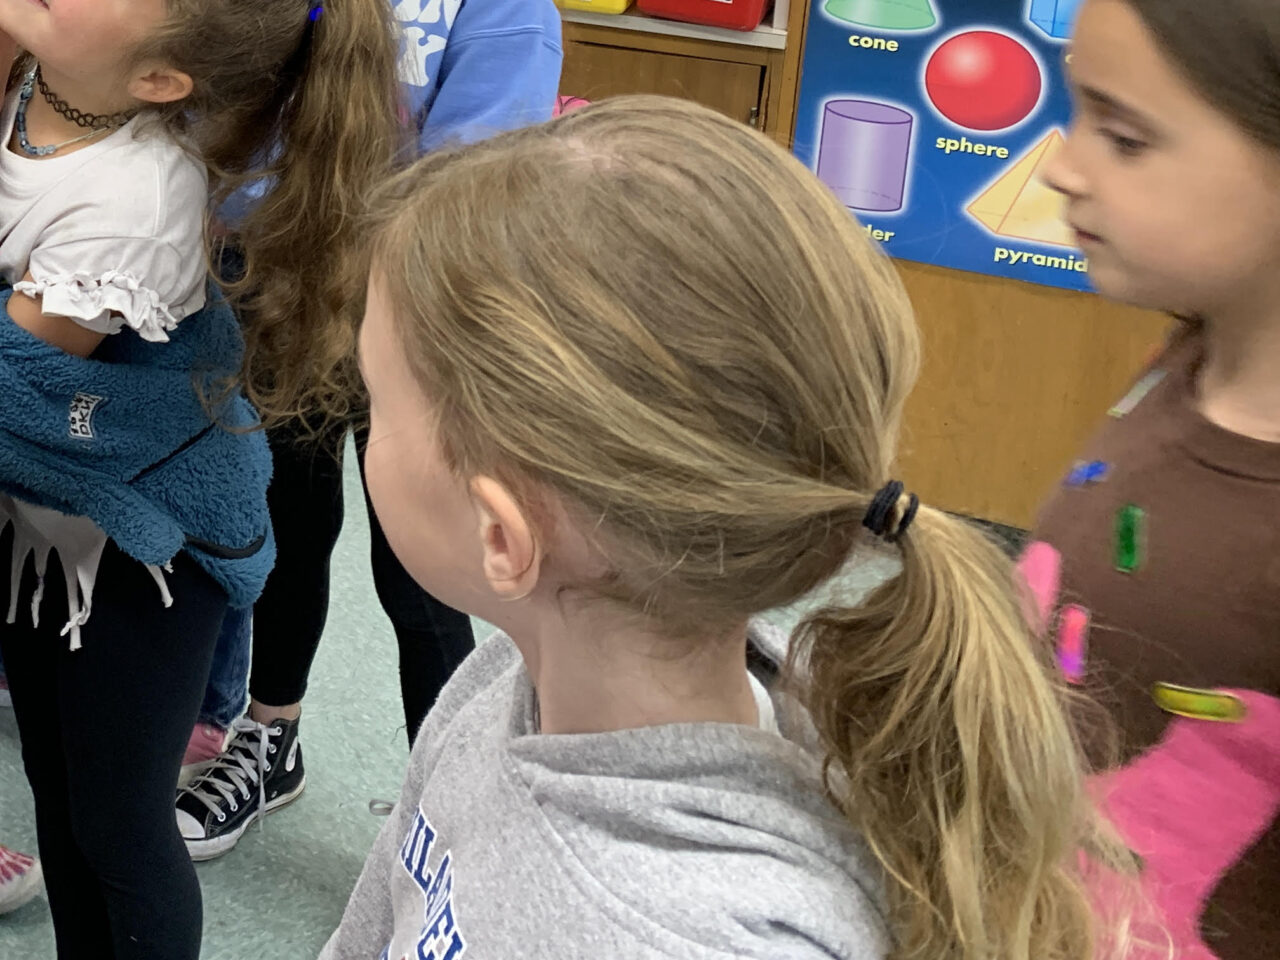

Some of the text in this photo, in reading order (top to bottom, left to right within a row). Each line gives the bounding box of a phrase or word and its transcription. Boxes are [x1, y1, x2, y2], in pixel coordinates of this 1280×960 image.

[848, 33, 899, 52] cone
[935, 136, 1009, 159] sphere
[993, 245, 1089, 273] pyramid
